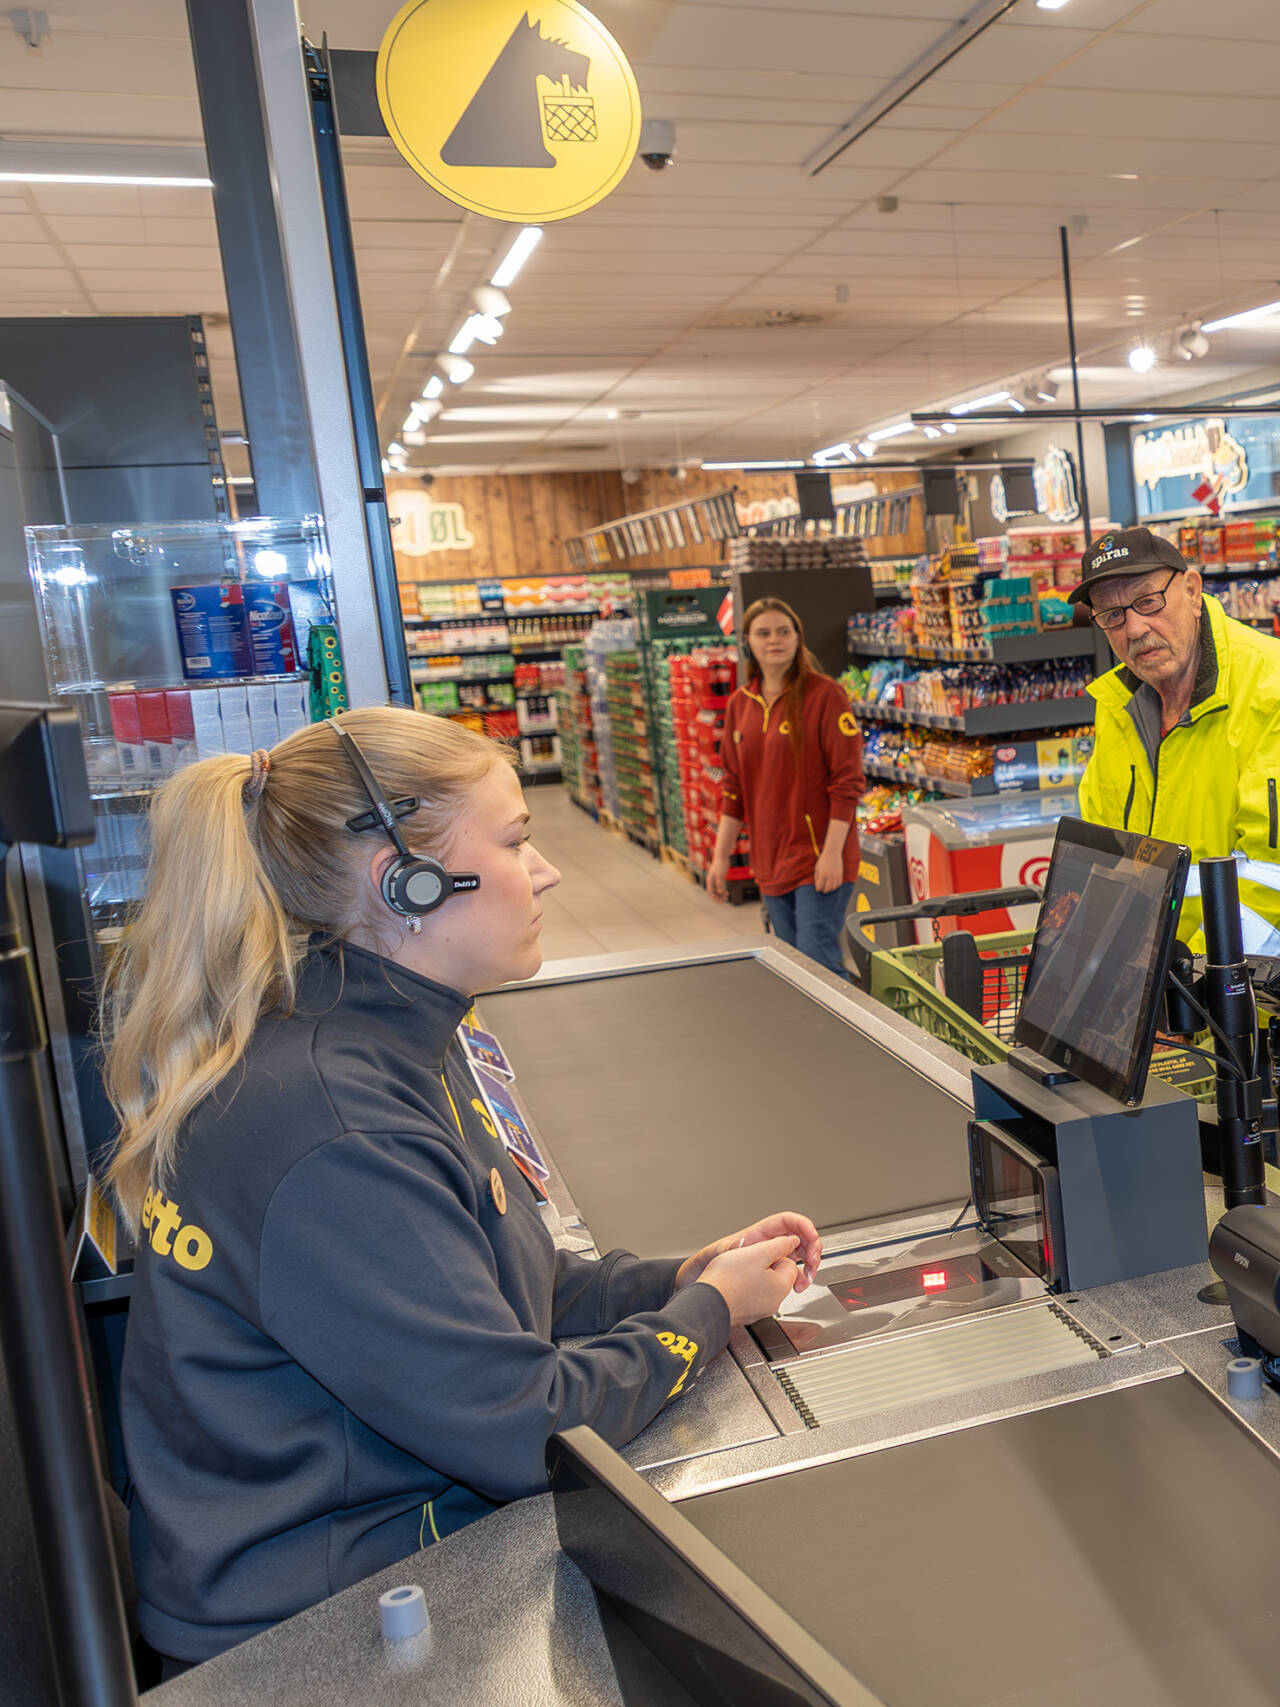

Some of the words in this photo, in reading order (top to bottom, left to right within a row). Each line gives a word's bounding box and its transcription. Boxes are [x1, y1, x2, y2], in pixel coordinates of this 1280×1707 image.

[430, 509, 465, 543] ØL
[1091, 547, 1130, 569] spiras
[1233, 1252, 1250, 1269] EPSON
